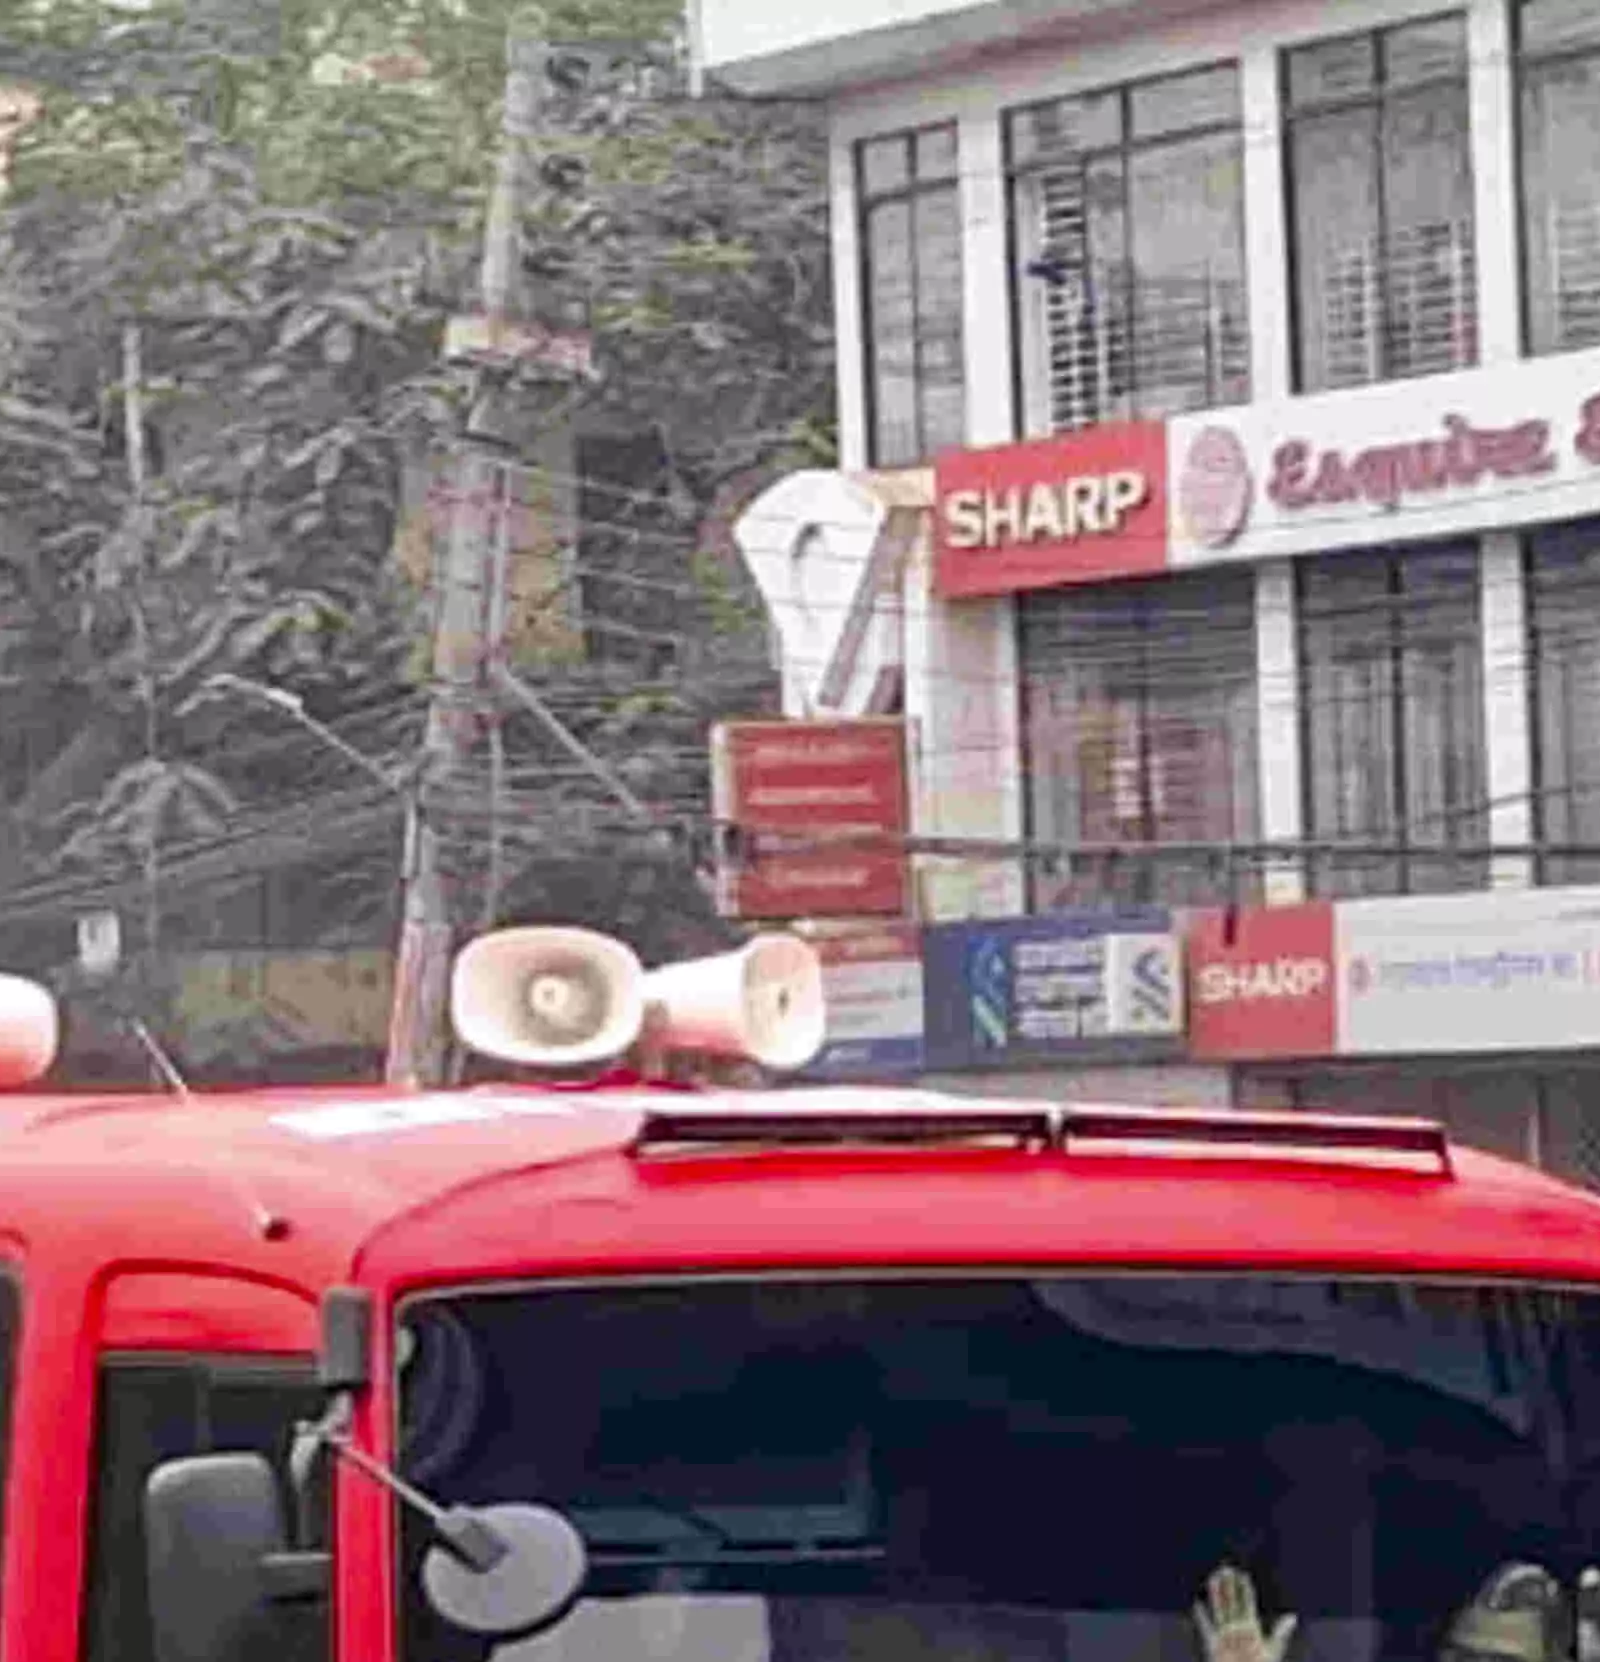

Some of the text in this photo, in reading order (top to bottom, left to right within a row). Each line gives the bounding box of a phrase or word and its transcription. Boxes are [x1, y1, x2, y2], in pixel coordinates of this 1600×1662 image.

[1268, 415, 1555, 510] Esquire
[944, 467, 1151, 549] SHARP
[1198, 957, 1328, 1001] SHARP
